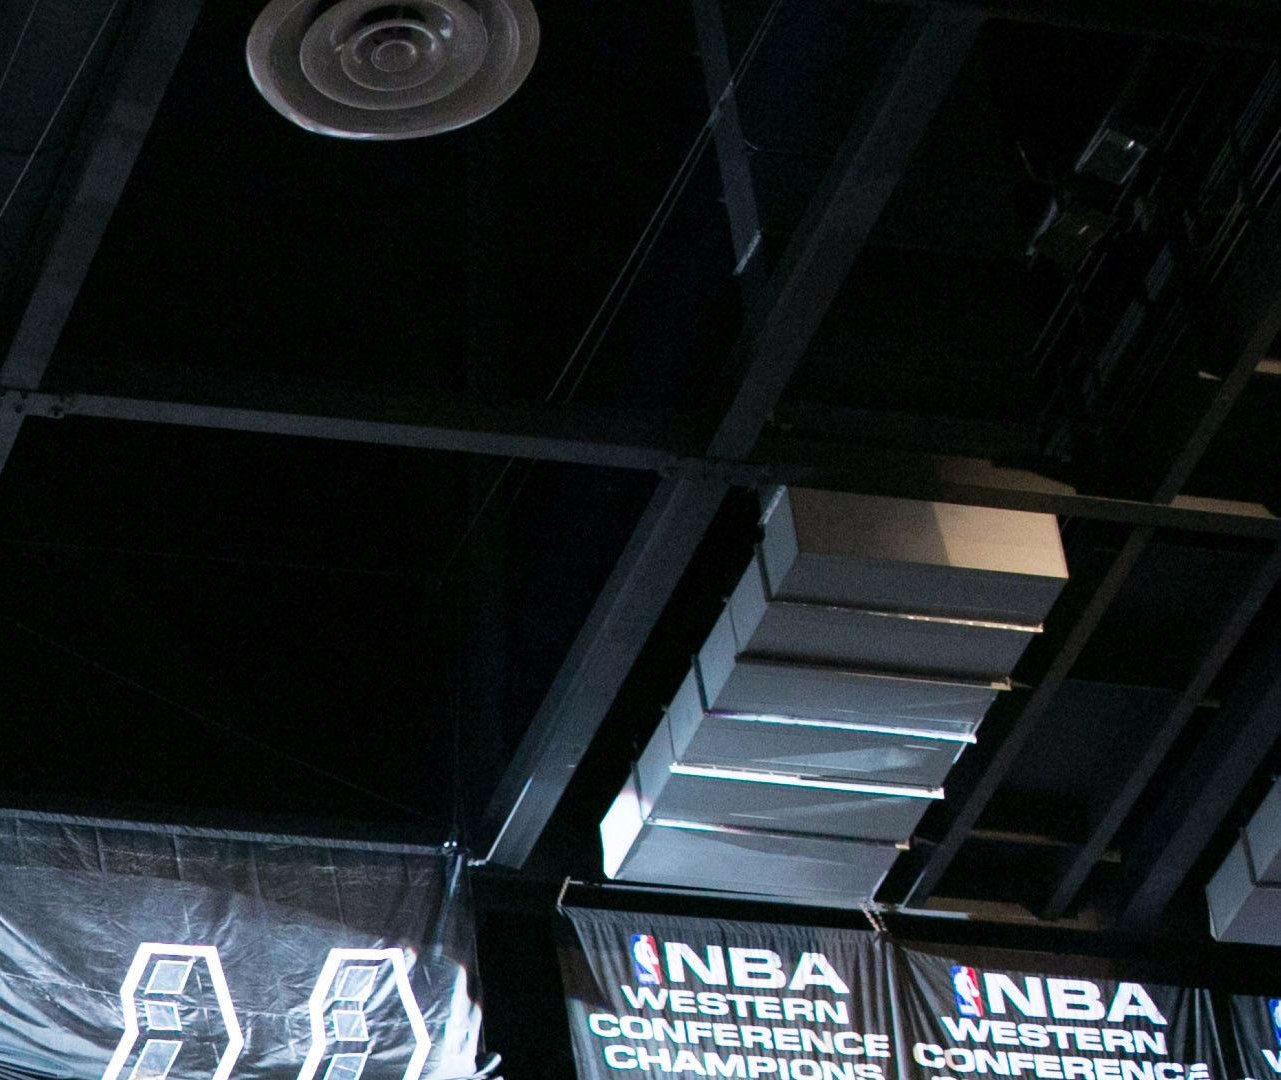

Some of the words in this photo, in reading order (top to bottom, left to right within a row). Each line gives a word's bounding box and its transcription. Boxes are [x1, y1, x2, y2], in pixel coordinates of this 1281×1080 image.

[665, 942, 850, 994] NBA
[621, 984, 849, 1025] WESTERN
[982, 972, 1168, 1026] NBA
[589, 1013, 891, 1059] CONFERENCE
[942, 1016, 1167, 1055] WESTERN
